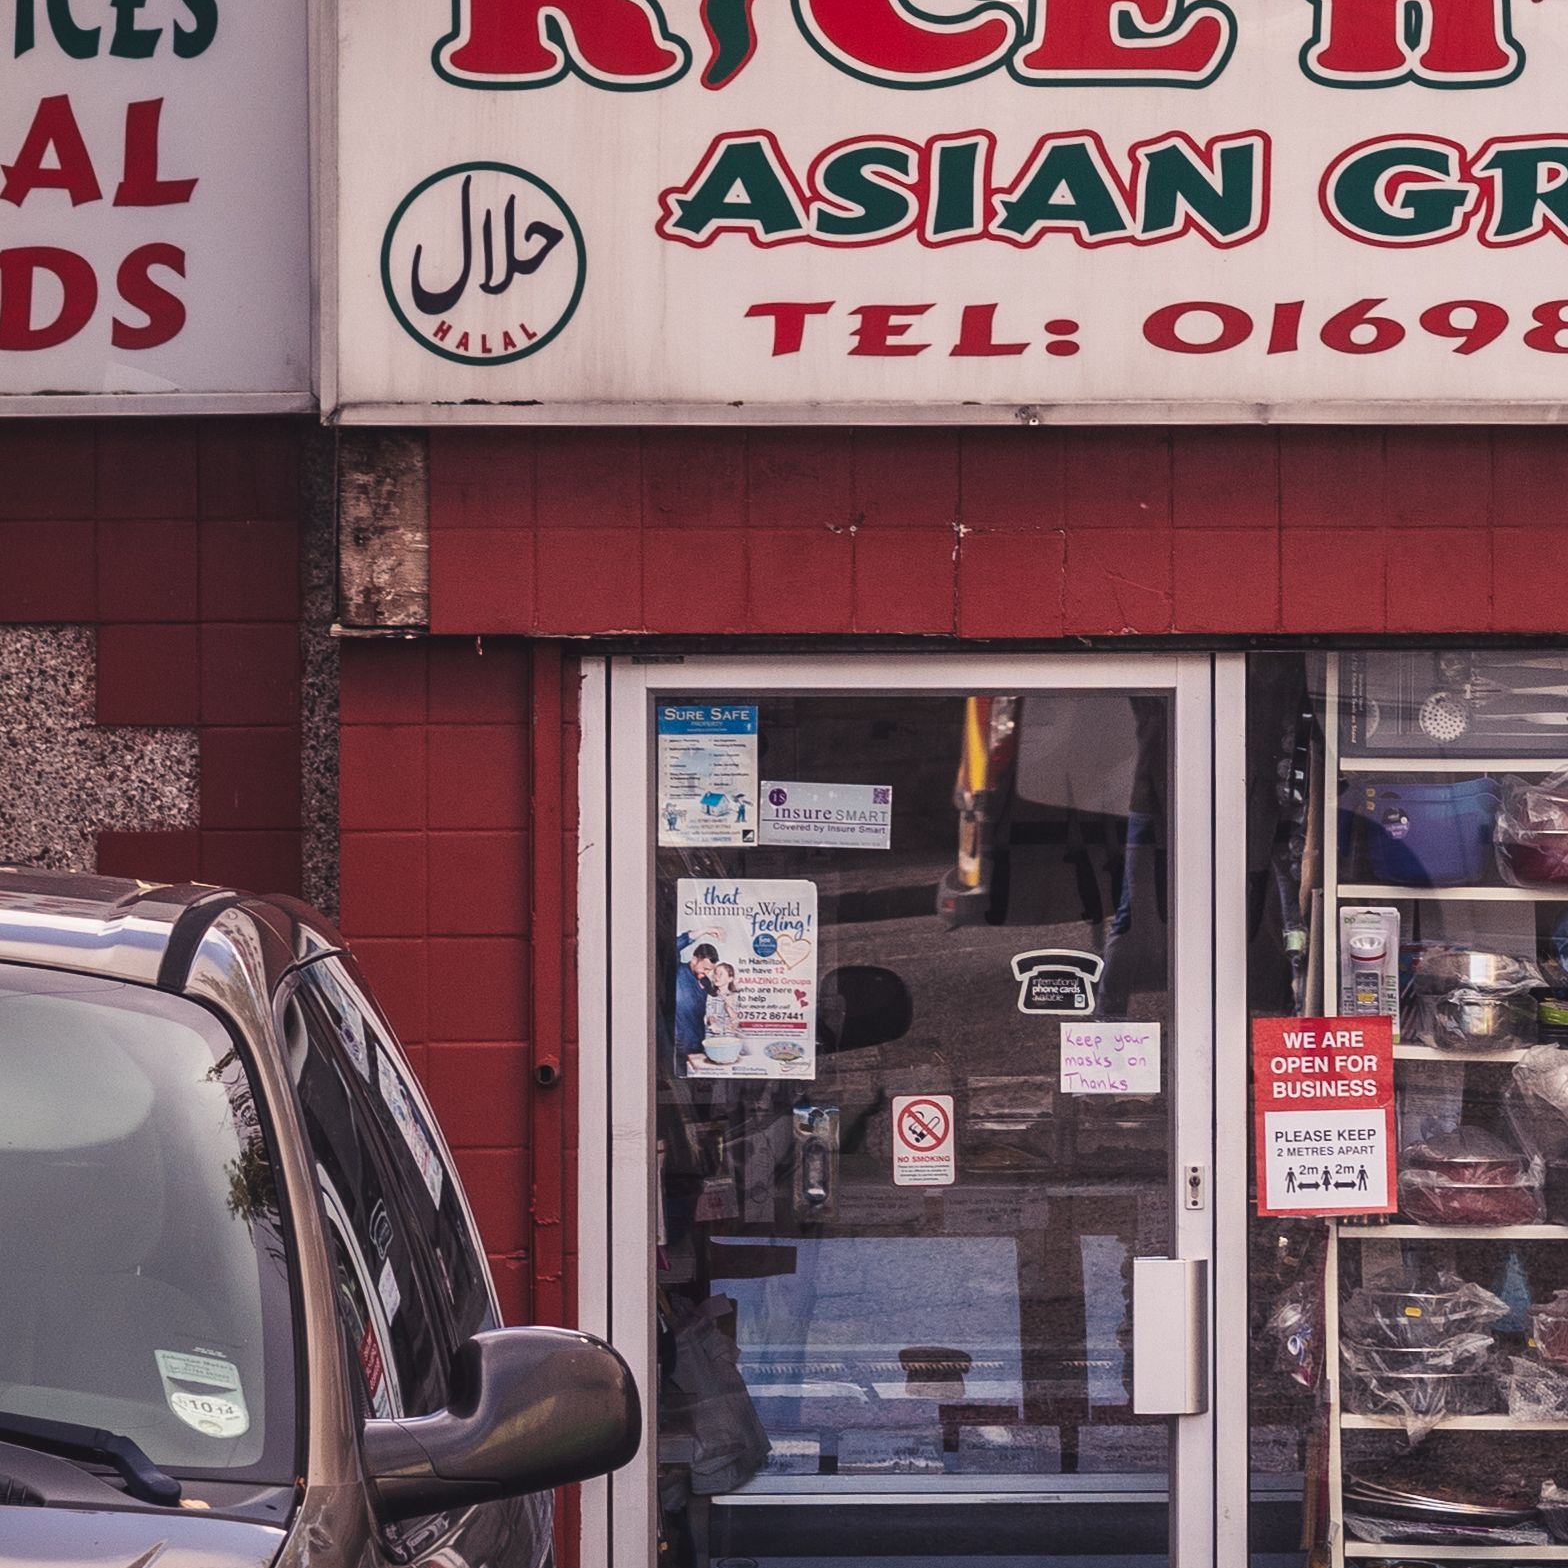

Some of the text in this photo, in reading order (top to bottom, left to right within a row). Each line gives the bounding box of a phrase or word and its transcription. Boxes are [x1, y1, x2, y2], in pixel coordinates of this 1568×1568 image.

[655, 128, 1273, 249] ASIAN
[411, 174, 565, 317] حلال
[432, 319, 538, 354] HALAL
[745, 299, 1080, 359] TEL:
[664, 708, 750, 721] SURE SAFE
[775, 807, 888, 822] insure SMART
[772, 822, 886, 834] Covered by Insure Smart
[704, 886, 742, 906] that
[684, 900, 800, 920] Slimming World
[750, 912, 812, 941] feeling!
[748, 957, 786, 965] Hamilton
[752, 967, 773, 975] have
[775, 967, 785, 975] 12
[738, 977, 812, 986] AMAZING Groups
[738, 986, 755, 994] who
[772, 986, 793, 994] here
[1032, 984, 1081, 995] phone cards
[748, 995, 767, 1003] help
[737, 1011, 805, 1021] 07572 867441
[1066, 1030, 1150, 1052] Keep your
[1283, 1030, 1364, 1049] WE ARE
[1065, 1050, 1147, 1068] masks on
[1270, 1054, 1378, 1074] OPEN FOR
[1063, 1071, 1129, 1091] Thanks
[1273, 1079, 1377, 1099] BUSINESS
[1275, 1128, 1377, 1143] PLEASE KEEP
[1277, 1145, 1376, 1157] 2 METRES APART
[911, 1155, 951, 1163] SMOKING
[1299, 1164, 1355, 1176] 2m 2m
[189, 1400, 234, 1415] 10 14
